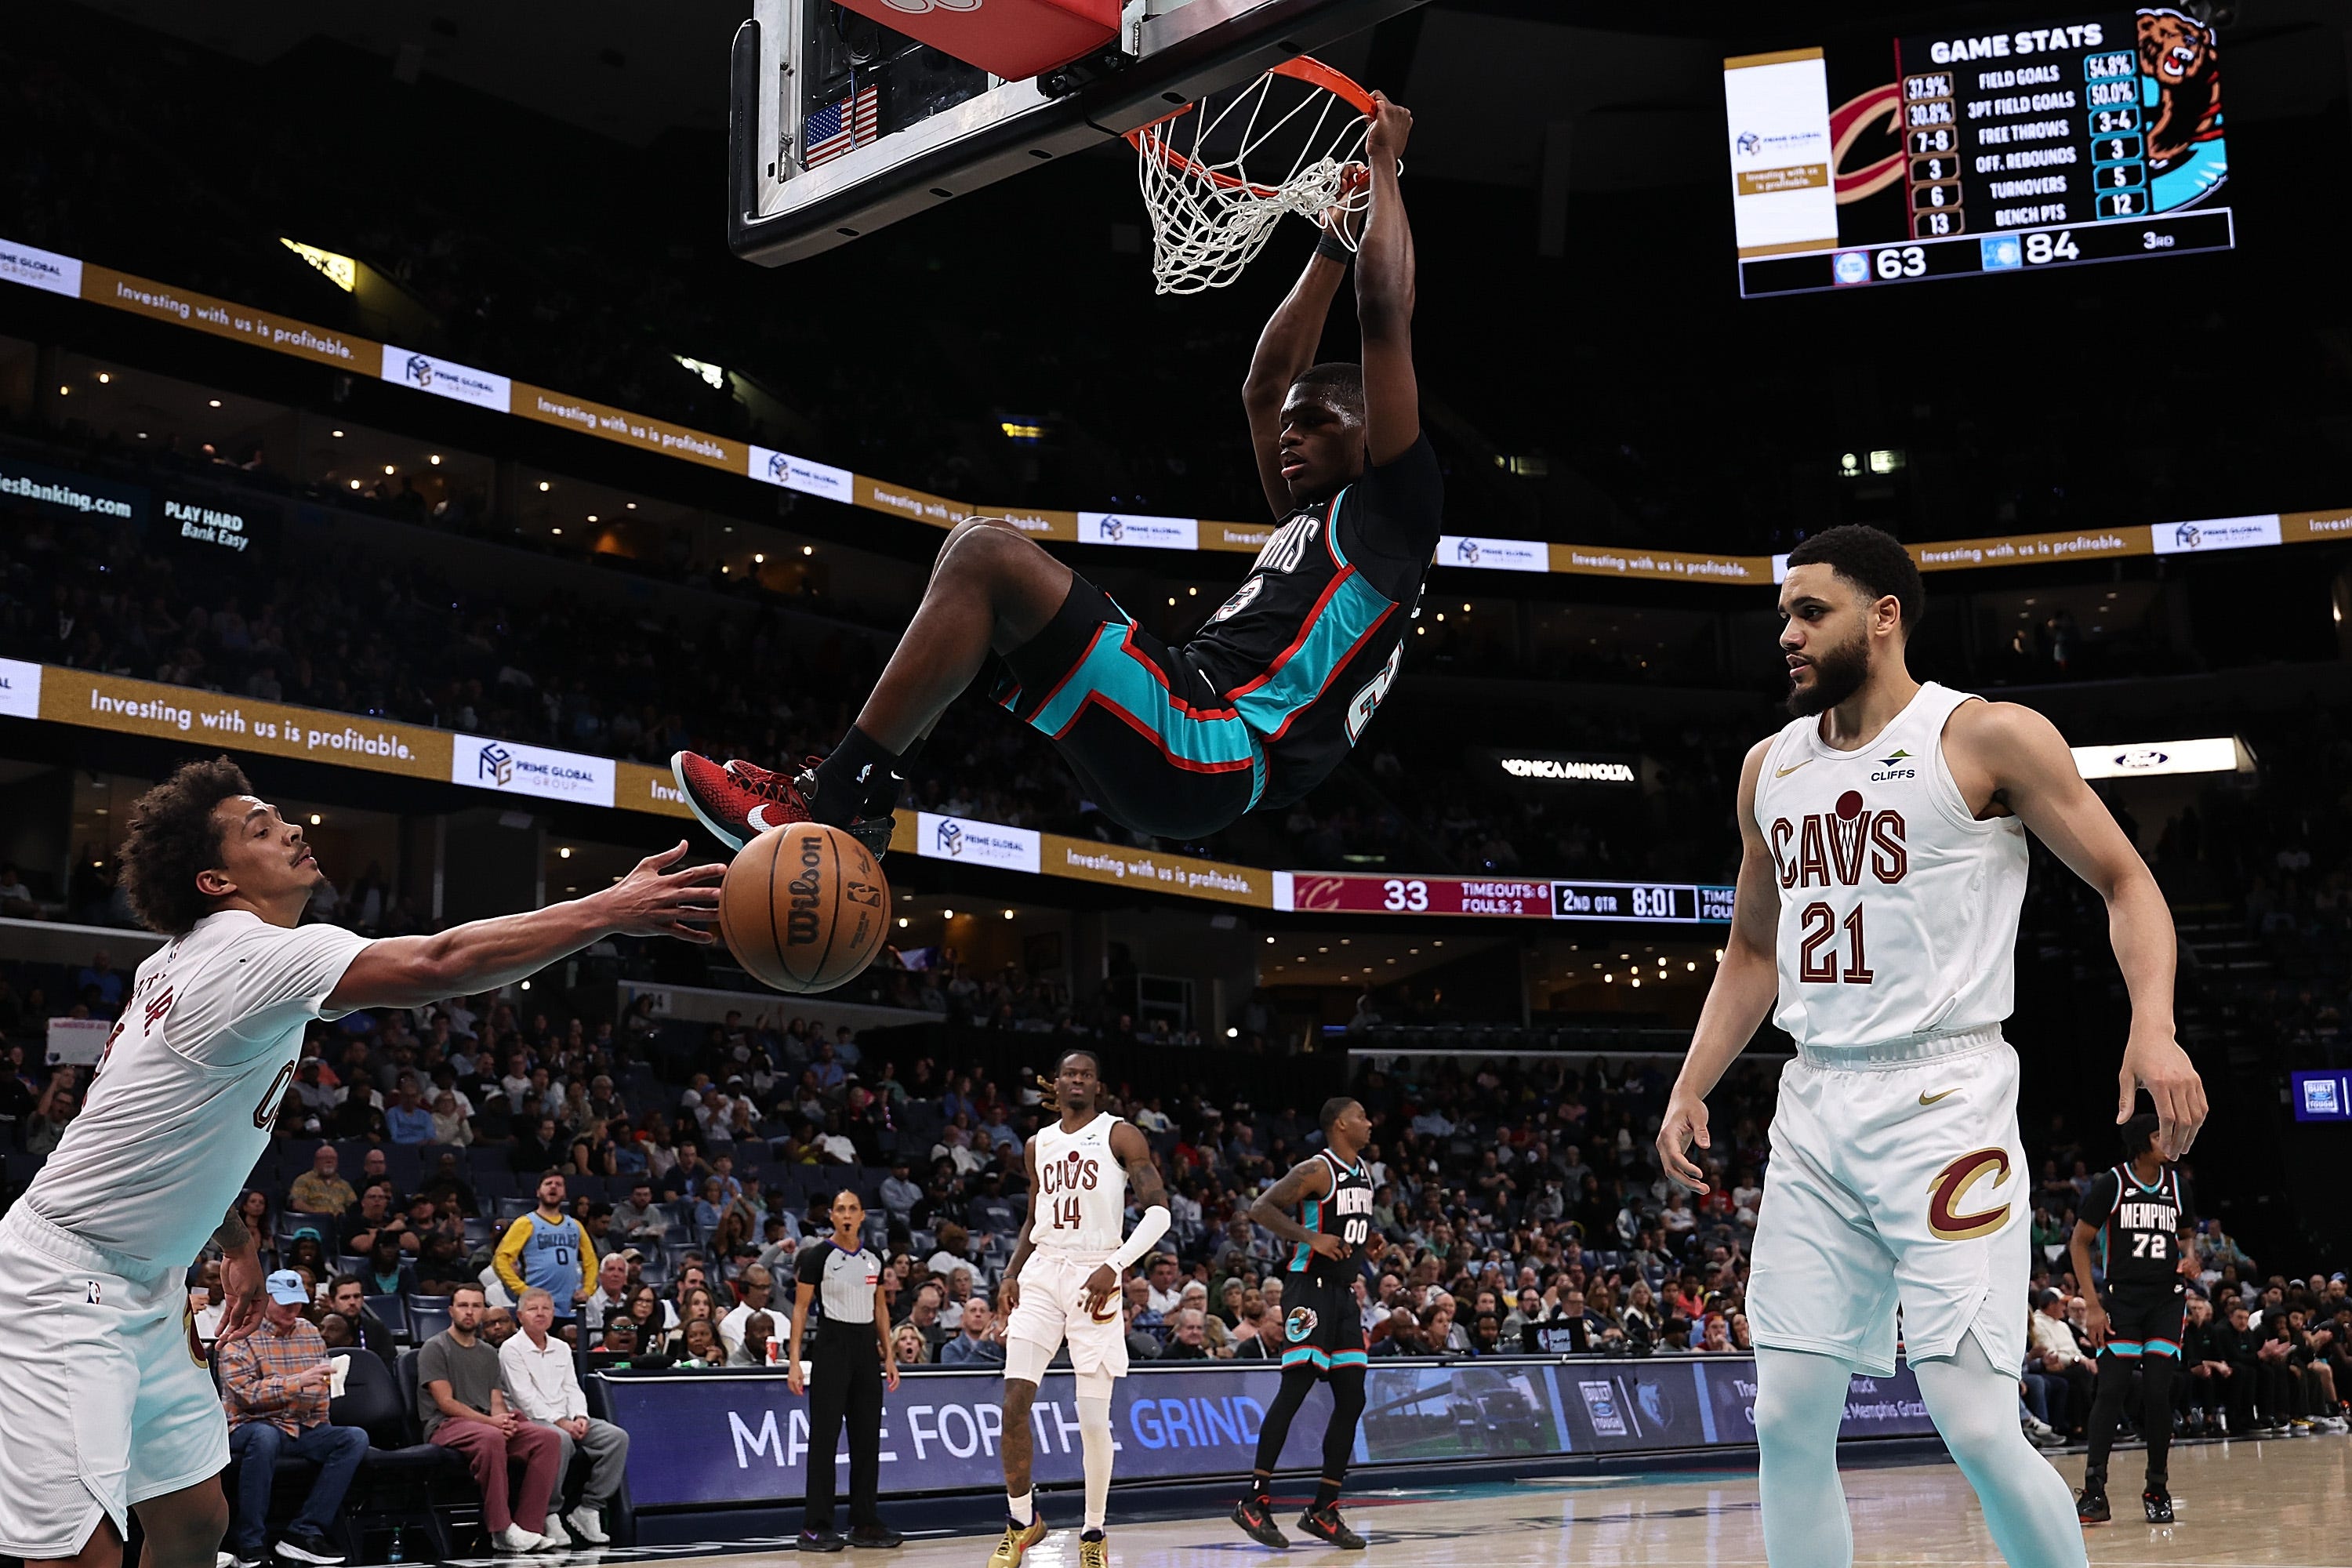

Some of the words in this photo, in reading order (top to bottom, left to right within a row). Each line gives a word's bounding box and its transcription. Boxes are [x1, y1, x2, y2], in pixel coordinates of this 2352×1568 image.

[1930, 34, 2010, 64] GAME
[2015, 24, 2103, 54] STATS
[1979, 68, 2015, 89] FIELD
[2016, 64, 2060, 85] GOALS
[2089, 54, 2131, 78] 54.8%
[1907, 75, 1950, 100] 37.9%
[2091, 81, 2133, 105] 50.0%
[1910, 103, 1951, 126] 30.8%
[1967, 100, 1992, 118] 3PT
[1994, 95, 2031, 115] FIELD
[2031, 90, 2076, 111] GOALS
[1979, 127, 2011, 145] FREE
[2011, 119, 2070, 141] THROWS
[2099, 109, 2132, 132] 3-4
[1917, 129, 1949, 152] 7-8
[2111, 139, 2124, 159] 3
[1929, 159, 1941, 180] 3
[1976, 155, 2005, 172] OFF.
[2005, 147, 2077, 165] REBOUNDS
[1746, 169, 1784, 182] Investing
[1785, 166, 1805, 177] with
[1806, 166, 1818, 176] us
[1755, 183, 1764, 191] is
[1765, 177, 1811, 191] profitable.
[2114, 166, 2126, 187] 5
[1931, 186, 1944, 207] 6
[1990, 176, 2067, 199] TURNOVERS
[1995, 207, 2040, 227] BENCH
[2041, 203, 2067, 222] PTS
[2112, 194, 2132, 216] 12
[1929, 213, 1950, 234] 13
[2026, 230, 2080, 263] 84
[2143, 231, 2176, 249] 3RD
[20, 257, 62, 276] GLOBAL
[1877, 246, 1927, 280] 63
[117, 281, 191, 320] Investing
[196, 307, 230, 326] with
[234, 318, 252, 333] us
[257, 320, 270, 337] is
[274, 327, 355, 361] profitable.
[434, 371, 459, 383] PRIME
[461, 376, 495, 393] GLOBAL
[537, 396, 597, 429] Investing
[600, 416, 628, 434] with
[631, 425, 646, 439] us
[649, 426, 660, 442] is
[662, 432, 728, 462] profitable.
[0, 472, 132, 519] iesBanking.com
[873, 488, 924, 517] Investing
[925, 503, 950, 519] with
[949, 510, 963, 523] us
[165, 500, 201, 524] PLAY
[202, 508, 245, 533] HARD
[181, 521, 216, 543] Bank
[217, 529, 250, 553] Easy
[1920, 546, 1982, 565] Investing
[1985, 542, 2015, 559] with
[2019, 543, 2035, 557] us
[2038, 539, 2049, 555] is
[2053, 534, 2127, 556] profitable.
[1572, 552, 1625, 574] Investing
[1628, 555, 1654, 570] with
[1657, 559, 1671, 572] us
[1673, 557, 1684, 572] is
[1686, 559, 1750, 579] profitable.
[90, 688, 191, 732] Investing
[201, 708, 246, 734] with
[253, 720, 278, 739] us
[284, 719, 301, 742] is
[307, 726, 416, 761] profitable.
[515, 760, 548, 775] PRIME
[550, 765, 595, 782] GLOBAL
[1501, 758, 1565, 779] KONICA
[1565, 761, 1635, 782] MINOLTA
[1871, 769, 1915, 782] CLIFFS
[532, 776, 579, 792] GROUP
[964, 833, 990, 848] PRIME
[991, 838, 1025, 852] GLOBAL
[1770, 809, 1908, 889] CAVS
[1066, 848, 1125, 878] Investing
[1127, 859, 1155, 878] with
[1158, 866, 1174, 880] us
[1175, 866, 1187, 884] is
[1189, 869, 1253, 894] profitable.
[786, 836, 824, 949] Wilson
[1382, 879, 1429, 912] 33
[1461, 882, 1535, 899] TIMEOUTS:
[1537, 884, 1548, 899] 6
[1563, 888, 1591, 913] 2ND
[1594, 896, 1617, 913] QTR
[1632, 887, 1676, 917] 8:01
[1461, 898, 1511, 914] FOULS:
[1512, 900, 1524, 914] 2
[1799, 901, 1875, 985] 21
[144, 985, 174, 1037] JR.
[2307, 1083, 2333, 1094] BUILT
[1043, 1159, 1099, 1195] CAVS
[1053, 1196, 1081, 1230] 14
[2120, 1203, 2177, 1233] MEMPHIS
[1343, 1218, 1369, 1245] 00
[555, 1247, 569, 1265] 0
[2131, 1232, 2168, 1260] 72
[1130, 1396, 1267, 1450] GRIND
[1848, 1401, 1899, 1421] Memphis
